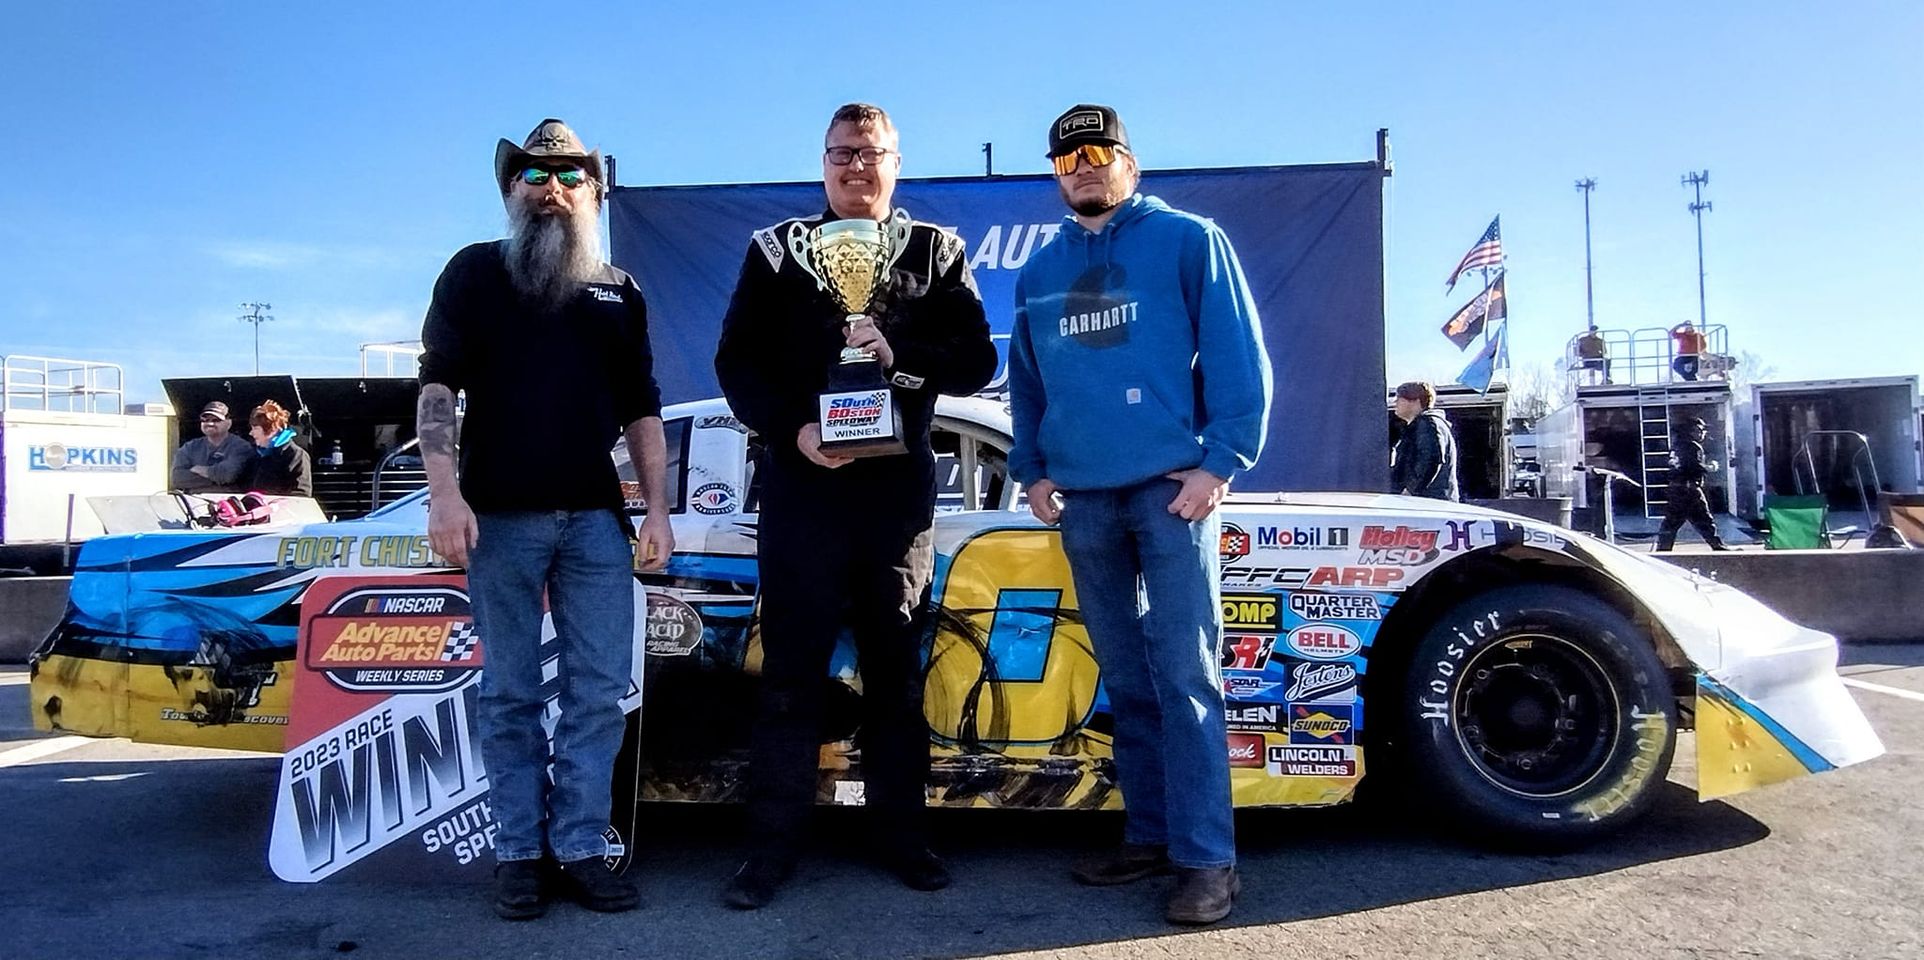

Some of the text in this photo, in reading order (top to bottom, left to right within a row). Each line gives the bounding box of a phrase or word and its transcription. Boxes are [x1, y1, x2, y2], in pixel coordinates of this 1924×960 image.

[1062, 117, 1099, 130] TRD
[970, 223, 1063, 270] AUT
[1059, 301, 1138, 337] CARHARTT
[834, 428, 880, 438] WINNER
[29, 442, 138, 471] HOPKINS
[1257, 526, 1346, 546] Mobil 1
[1359, 525, 1439, 550] Holley
[277, 535, 358, 569] FORT
[1358, 550, 1433, 566] MSD
[1221, 567, 1311, 583] PFC
[1309, 567, 1405, 587] ARP
[384, 598, 445, 613] NASCAR
[1222, 602, 1276, 623] OMP
[1291, 595, 1374, 612] QUARTER
[1306, 606, 1378, 619] MASTER
[645, 605, 684, 623] LACK
[335, 621, 442, 644] Advance
[1298, 631, 1351, 649] BELL
[320, 644, 435, 662] Auto Parts
[355, 670, 444, 683] WEEKLY SERIES
[1419, 610, 1500, 728] Hoosier
[1225, 705, 1277, 723] ELEN
[1294, 720, 1349, 731] SUNOCO
[291, 708, 394, 779] 2023 RACE
[1272, 748, 1340, 761] LINCOLN
[1584, 704, 1668, 822] Hoosier
[1287, 764, 1348, 775] WELDERS
